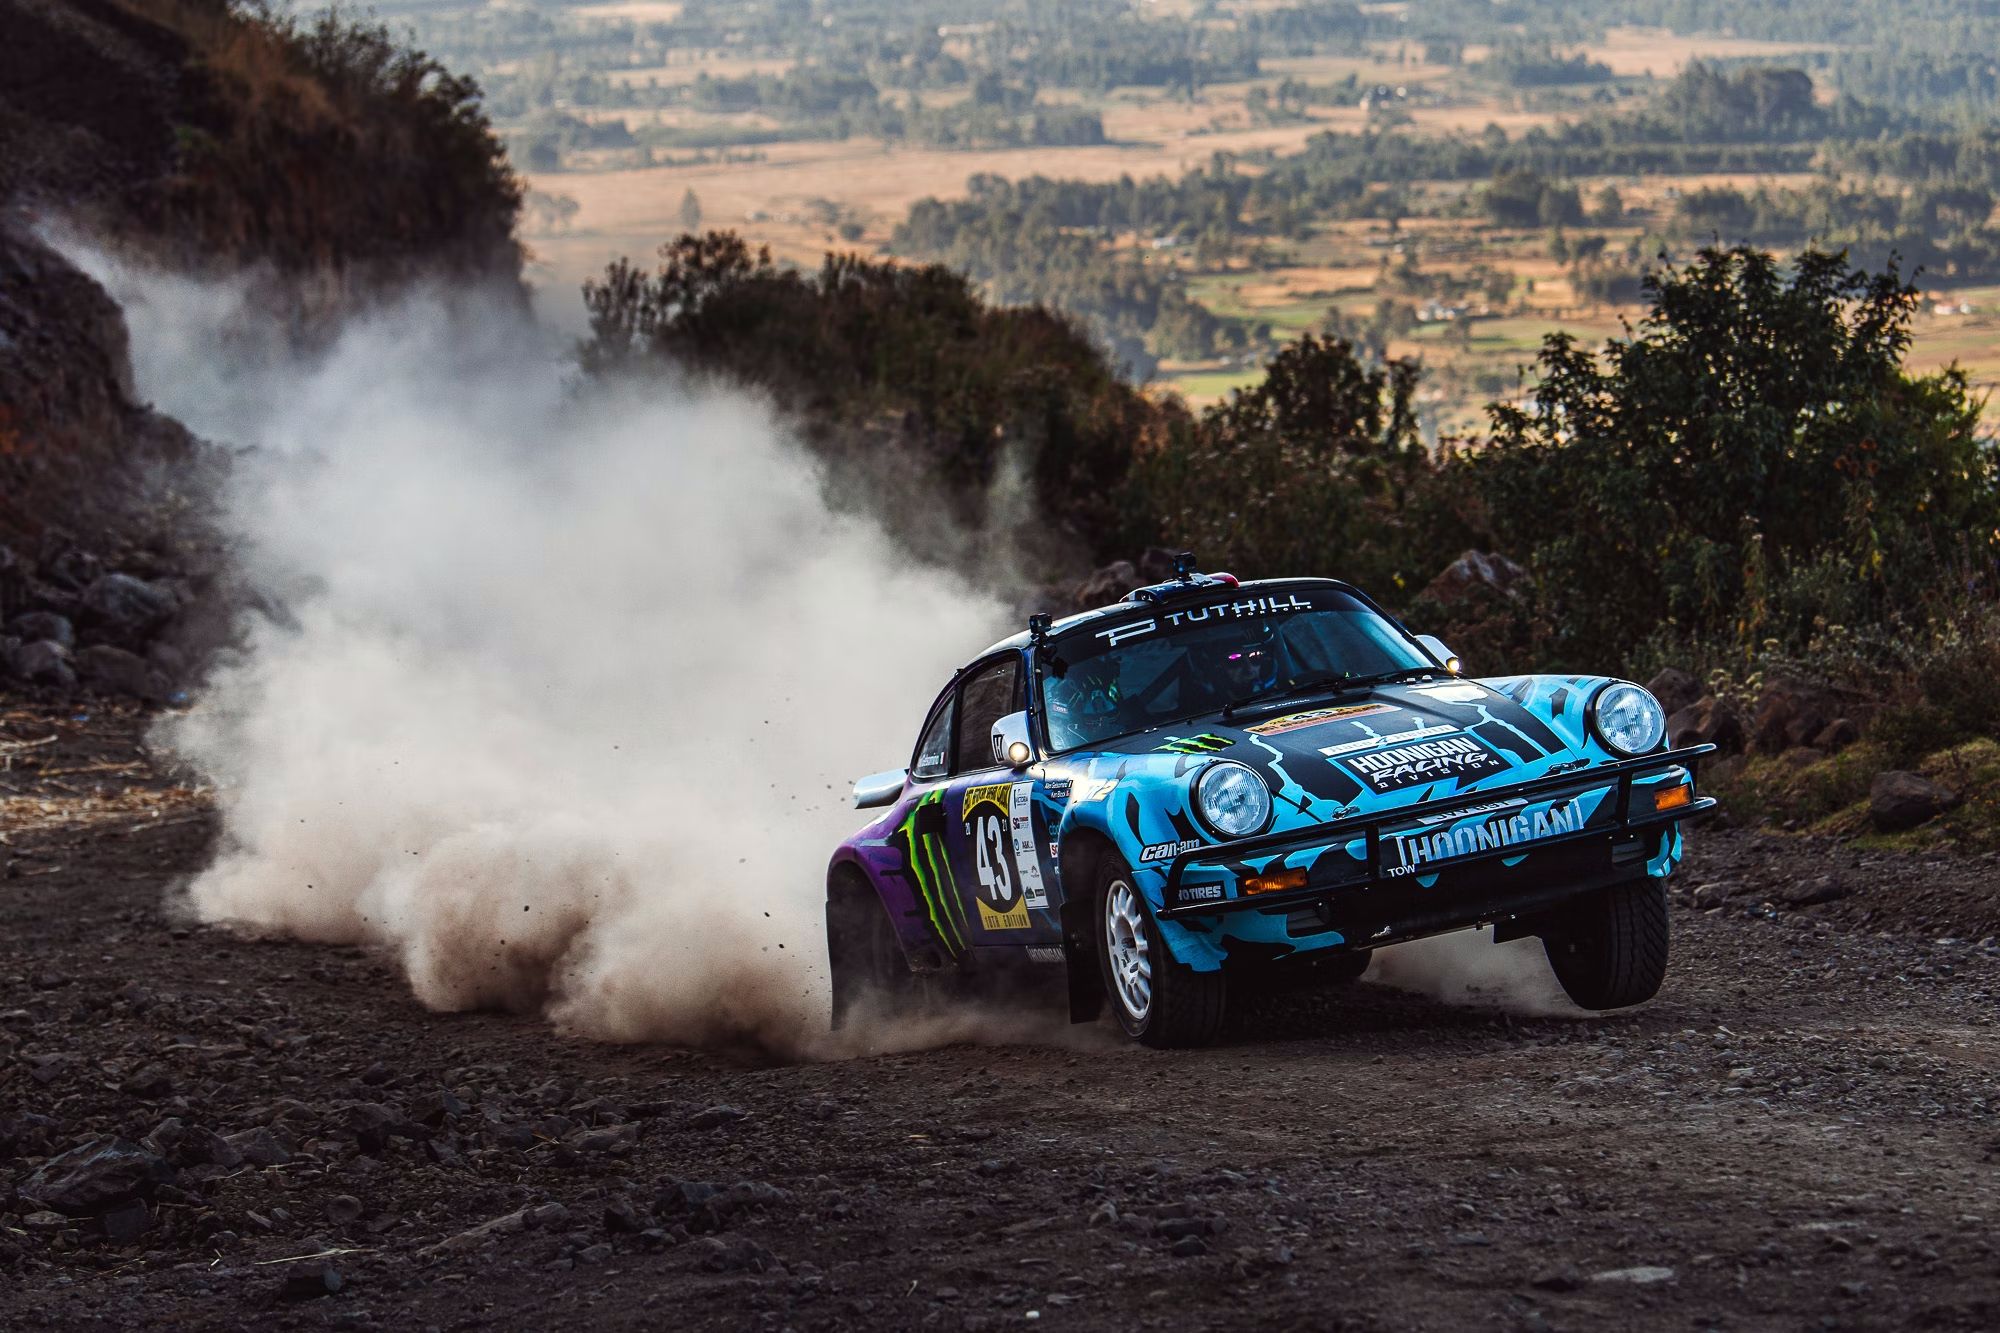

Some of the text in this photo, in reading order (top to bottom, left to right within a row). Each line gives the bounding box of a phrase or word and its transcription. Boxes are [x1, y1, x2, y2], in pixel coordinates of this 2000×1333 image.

[1164, 595, 1311, 626] TUTHILL
[1347, 737, 1482, 774] HOONIGAN
[1370, 752, 1488, 784] RACING
[1377, 760, 1500, 789] DIVISION
[976, 815, 1012, 900] 43
[1387, 863, 1415, 878] TOW
[1191, 885, 1221, 899] TIRES
[1003, 913, 1028, 928] EDITION
